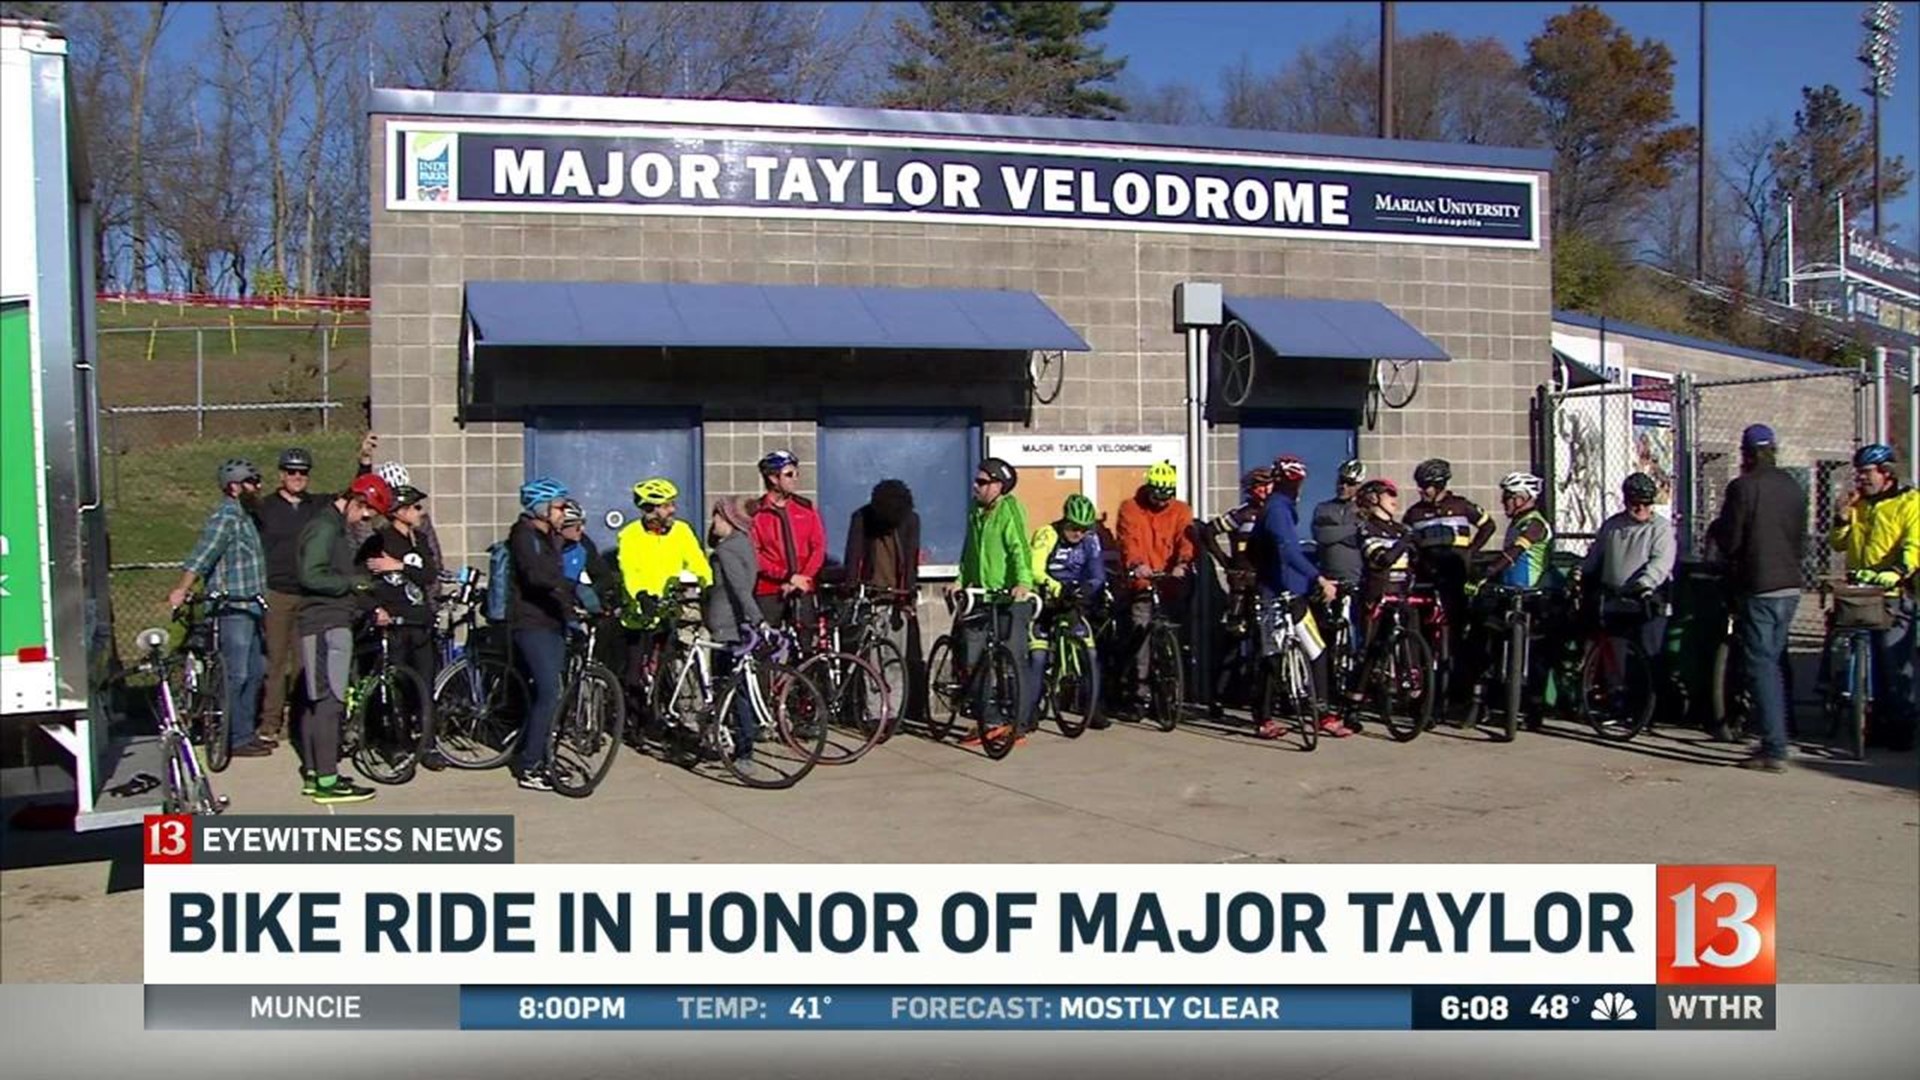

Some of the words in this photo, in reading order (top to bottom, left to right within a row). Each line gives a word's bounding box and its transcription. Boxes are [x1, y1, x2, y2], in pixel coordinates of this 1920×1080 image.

[494, 148, 719, 202] MAJOR
[746, 154, 982, 208] TAYLOR
[1000, 166, 1350, 226] VELODROME
[1374, 194, 1436, 213] MARIAN
[1438, 198, 1521, 218] UNIVERSITY
[1415, 216, 1482, 227] Indianapolis
[1022, 443, 1055, 453] MAJOR
[1058, 443, 1094, 453] TAYLOR
[1097, 443, 1153, 453] VELODROME
